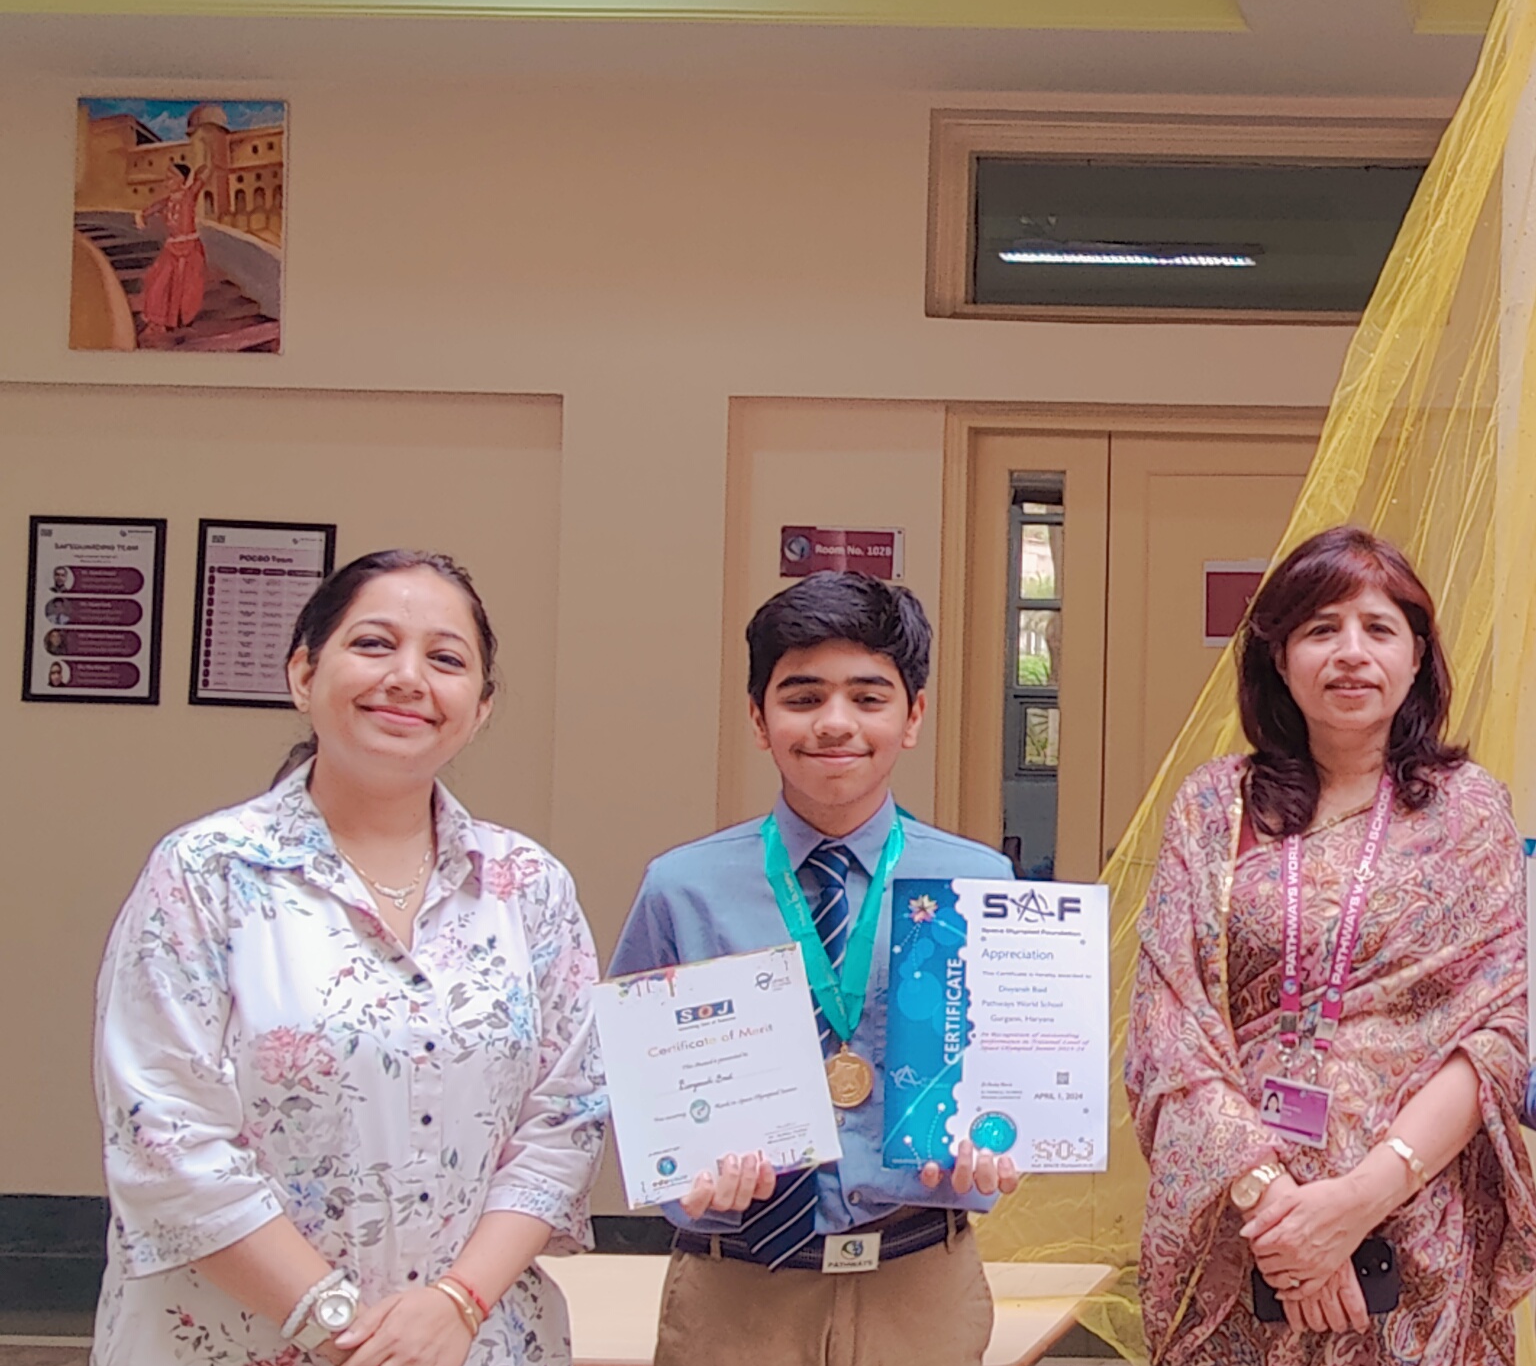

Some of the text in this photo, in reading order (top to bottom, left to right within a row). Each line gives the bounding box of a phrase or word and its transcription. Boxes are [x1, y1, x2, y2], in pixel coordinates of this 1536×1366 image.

[815, 544, 845, 555] Room
[846, 545, 864, 555] No.
[1286, 886, 1298, 977] PATHWAYS
[1331, 895, 1361, 985] PATHWAYS
[981, 948, 1054, 961] Appreciation
[679, 1000, 732, 1023] SOJ
[944, 957, 963, 1066] CERTIFICATE
[982, 1000, 1015, 1008] Pathways
[648, 1036, 717, 1058] Certificate
[721, 1028, 734, 1044] of
[739, 1024, 773, 1039] Merit
